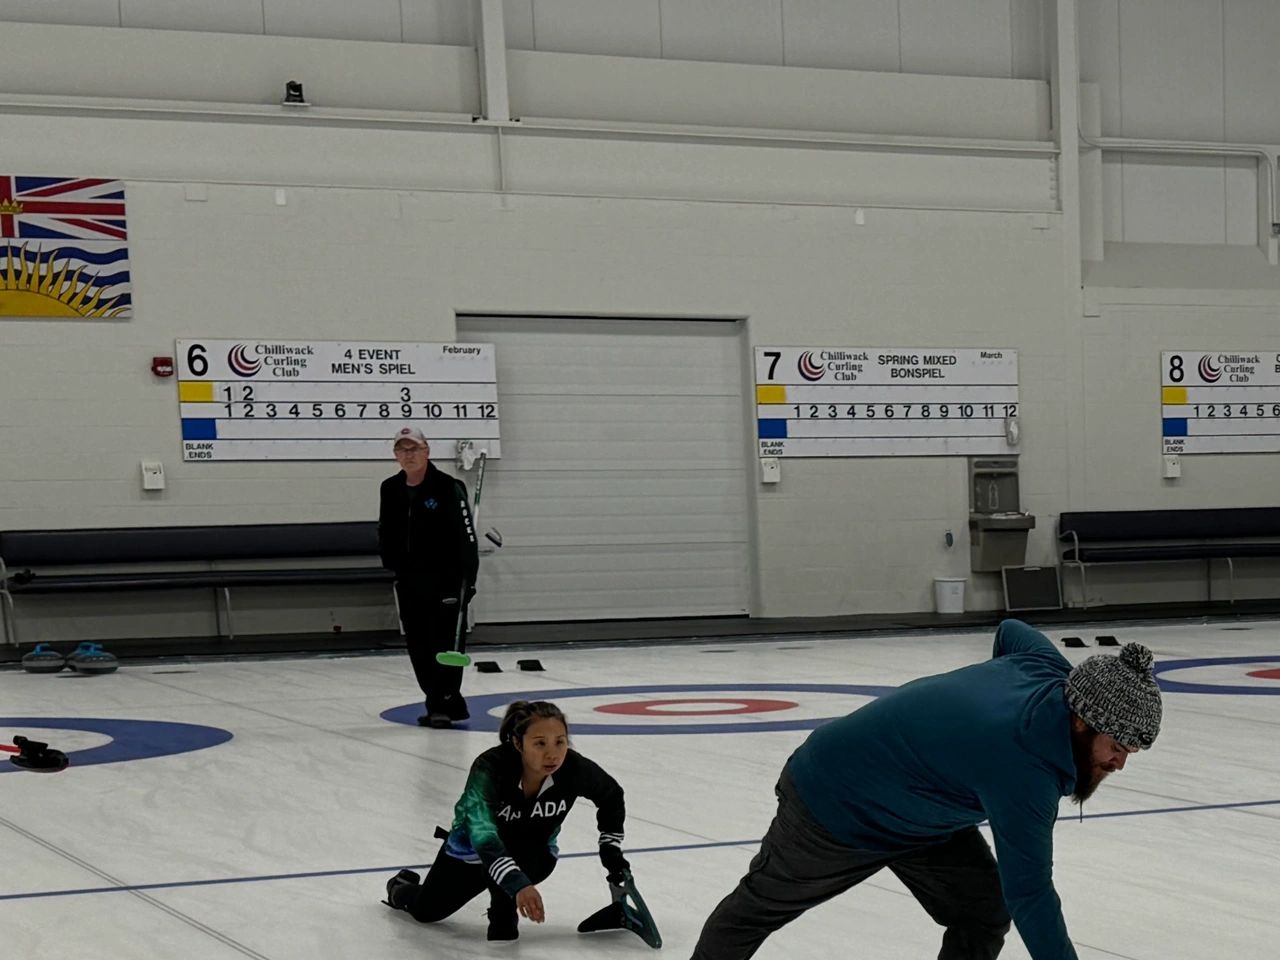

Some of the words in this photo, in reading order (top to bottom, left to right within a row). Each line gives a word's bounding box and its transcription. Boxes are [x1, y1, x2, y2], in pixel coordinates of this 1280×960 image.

[255, 344, 314, 355] Chilliwack
[344, 349, 353, 360] 4
[358, 349, 402, 360] EVENT
[443, 345, 481, 355] February
[187, 344, 208, 376] 6
[820, 351, 869, 361] Chilliwack
[878, 355, 919, 365] SPRING
[923, 356, 957, 365] MIXED
[1217, 354, 1260, 363] Chilliwack
[264, 356, 307, 368] Curling
[763, 352, 781, 380] 7
[827, 362, 863, 372] Curling
[272, 367, 300, 377] Club
[331, 363, 373, 374] MEN'S
[379, 364, 416, 375] SPIEL
[890, 368, 945, 378] BONSPIEL
[1169, 355, 1184, 382] 8
[1223, 364, 1255, 374] Curling
[834, 372, 857, 381] Club
[1229, 374, 1249, 382] Club
[223, 386, 232, 401] 1
[242, 386, 254, 401] 2
[400, 387, 411, 402] 3
[224, 404, 232, 417] 1
[243, 404, 254, 417] 2
[266, 404, 277, 417] 3
[289, 404, 300, 417] 4
[312, 404, 323, 417] 5
[335, 404, 346, 417] 6
[357, 404, 367, 417] 7
[379, 404, 390, 417] 8
[401, 405, 412, 418] 9
[424, 405, 442, 418] 10
[453, 405, 467, 418] 11
[478, 405, 496, 418] 12
[794, 406, 800, 418] 1
[810, 405, 819, 417] 2
[828, 405, 838, 417] 3
[847, 405, 856, 417] 4
[866, 405, 876, 417] 5
[885, 405, 894, 417] 6
[903, 405, 911, 417] 7
[921, 405, 930, 417] 8
[939, 405, 949, 417] 9
[958, 405, 973, 417] 10
[982, 405, 994, 417] 11
[1002, 405, 1017, 417] 12
[1194, 405, 1199, 417] 1
[1207, 405, 1216, 417] 2
[1224, 405, 1232, 417] 3
[1240, 405, 1248, 416] 4
[1256, 405, 1264, 416] 5
[1272, 405, 1280, 416] 6
[185, 443, 214, 451] BLANK
[188, 451, 212, 459] ENDS
